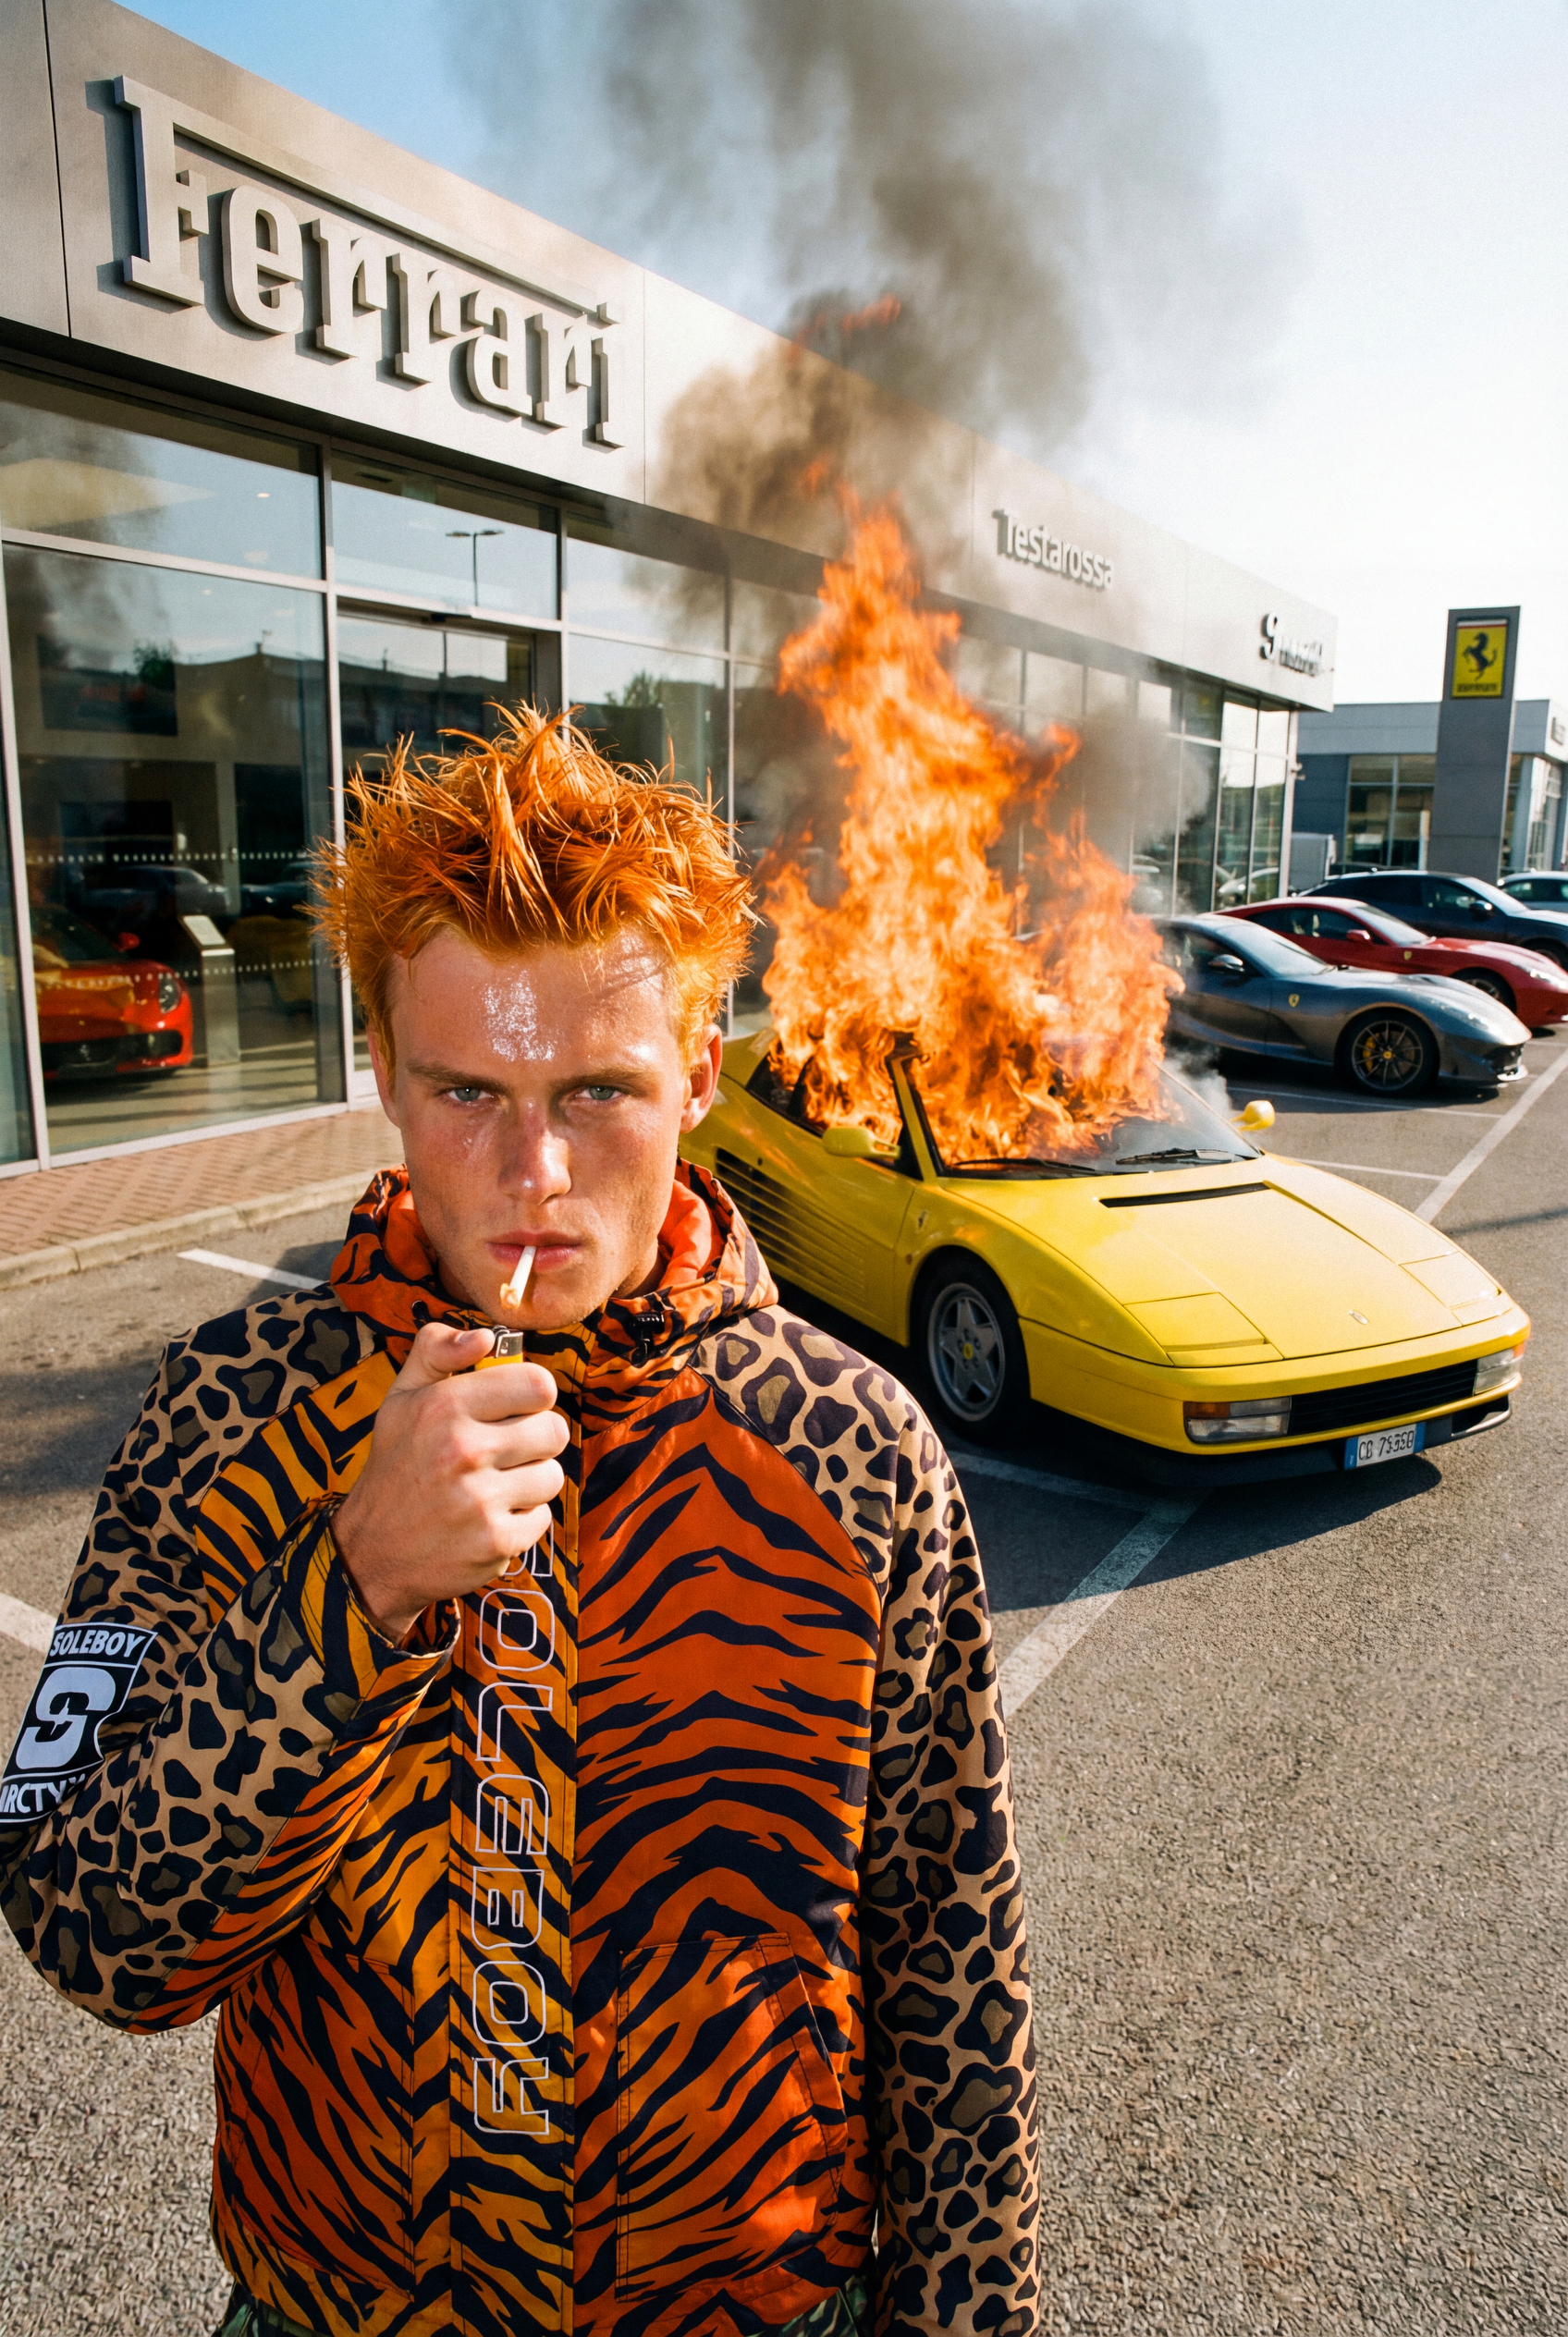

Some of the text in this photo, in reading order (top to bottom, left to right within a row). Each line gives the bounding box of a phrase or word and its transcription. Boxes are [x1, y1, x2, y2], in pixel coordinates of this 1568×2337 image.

[114, 75, 626, 448] Ferrari
[998, 508, 1115, 590] Testarossa
[49, 1629, 146, 1658] SOLEBOY
